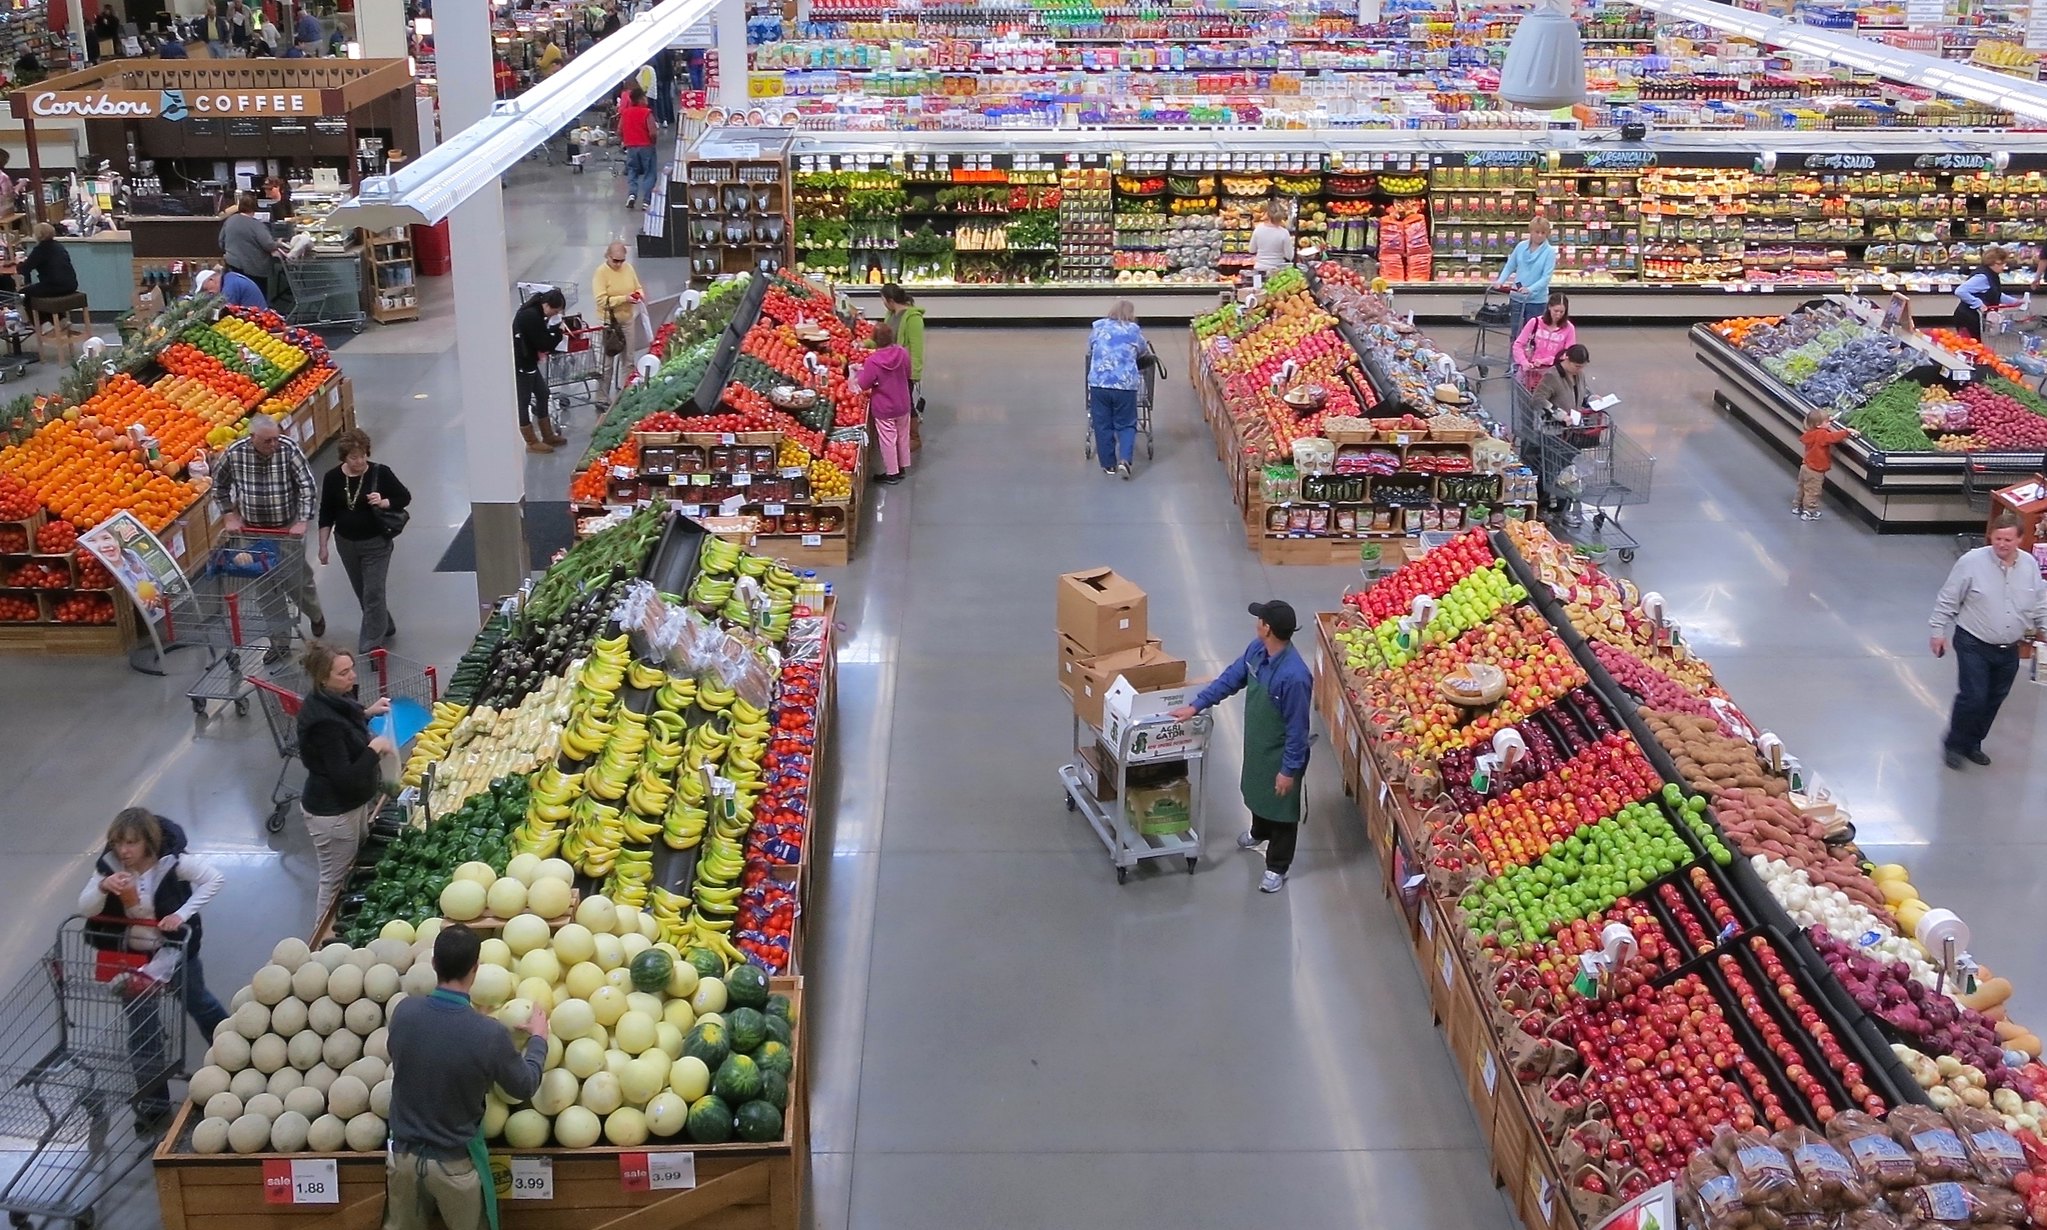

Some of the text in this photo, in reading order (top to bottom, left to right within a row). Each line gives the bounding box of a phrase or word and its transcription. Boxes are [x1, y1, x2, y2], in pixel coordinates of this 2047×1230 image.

[32, 93, 304, 116] Caribou COFFEE
[1161, 725, 1180, 733] AGRI
[1156, 731, 1184, 740] GATOR
[623, 1170, 647, 1178] sale
[652, 1172, 681, 1182] 3.99
[267, 1176, 291, 1186] sale
[515, 1178, 544, 1189] 3.99
[297, 1183, 325, 1193] 1.88
